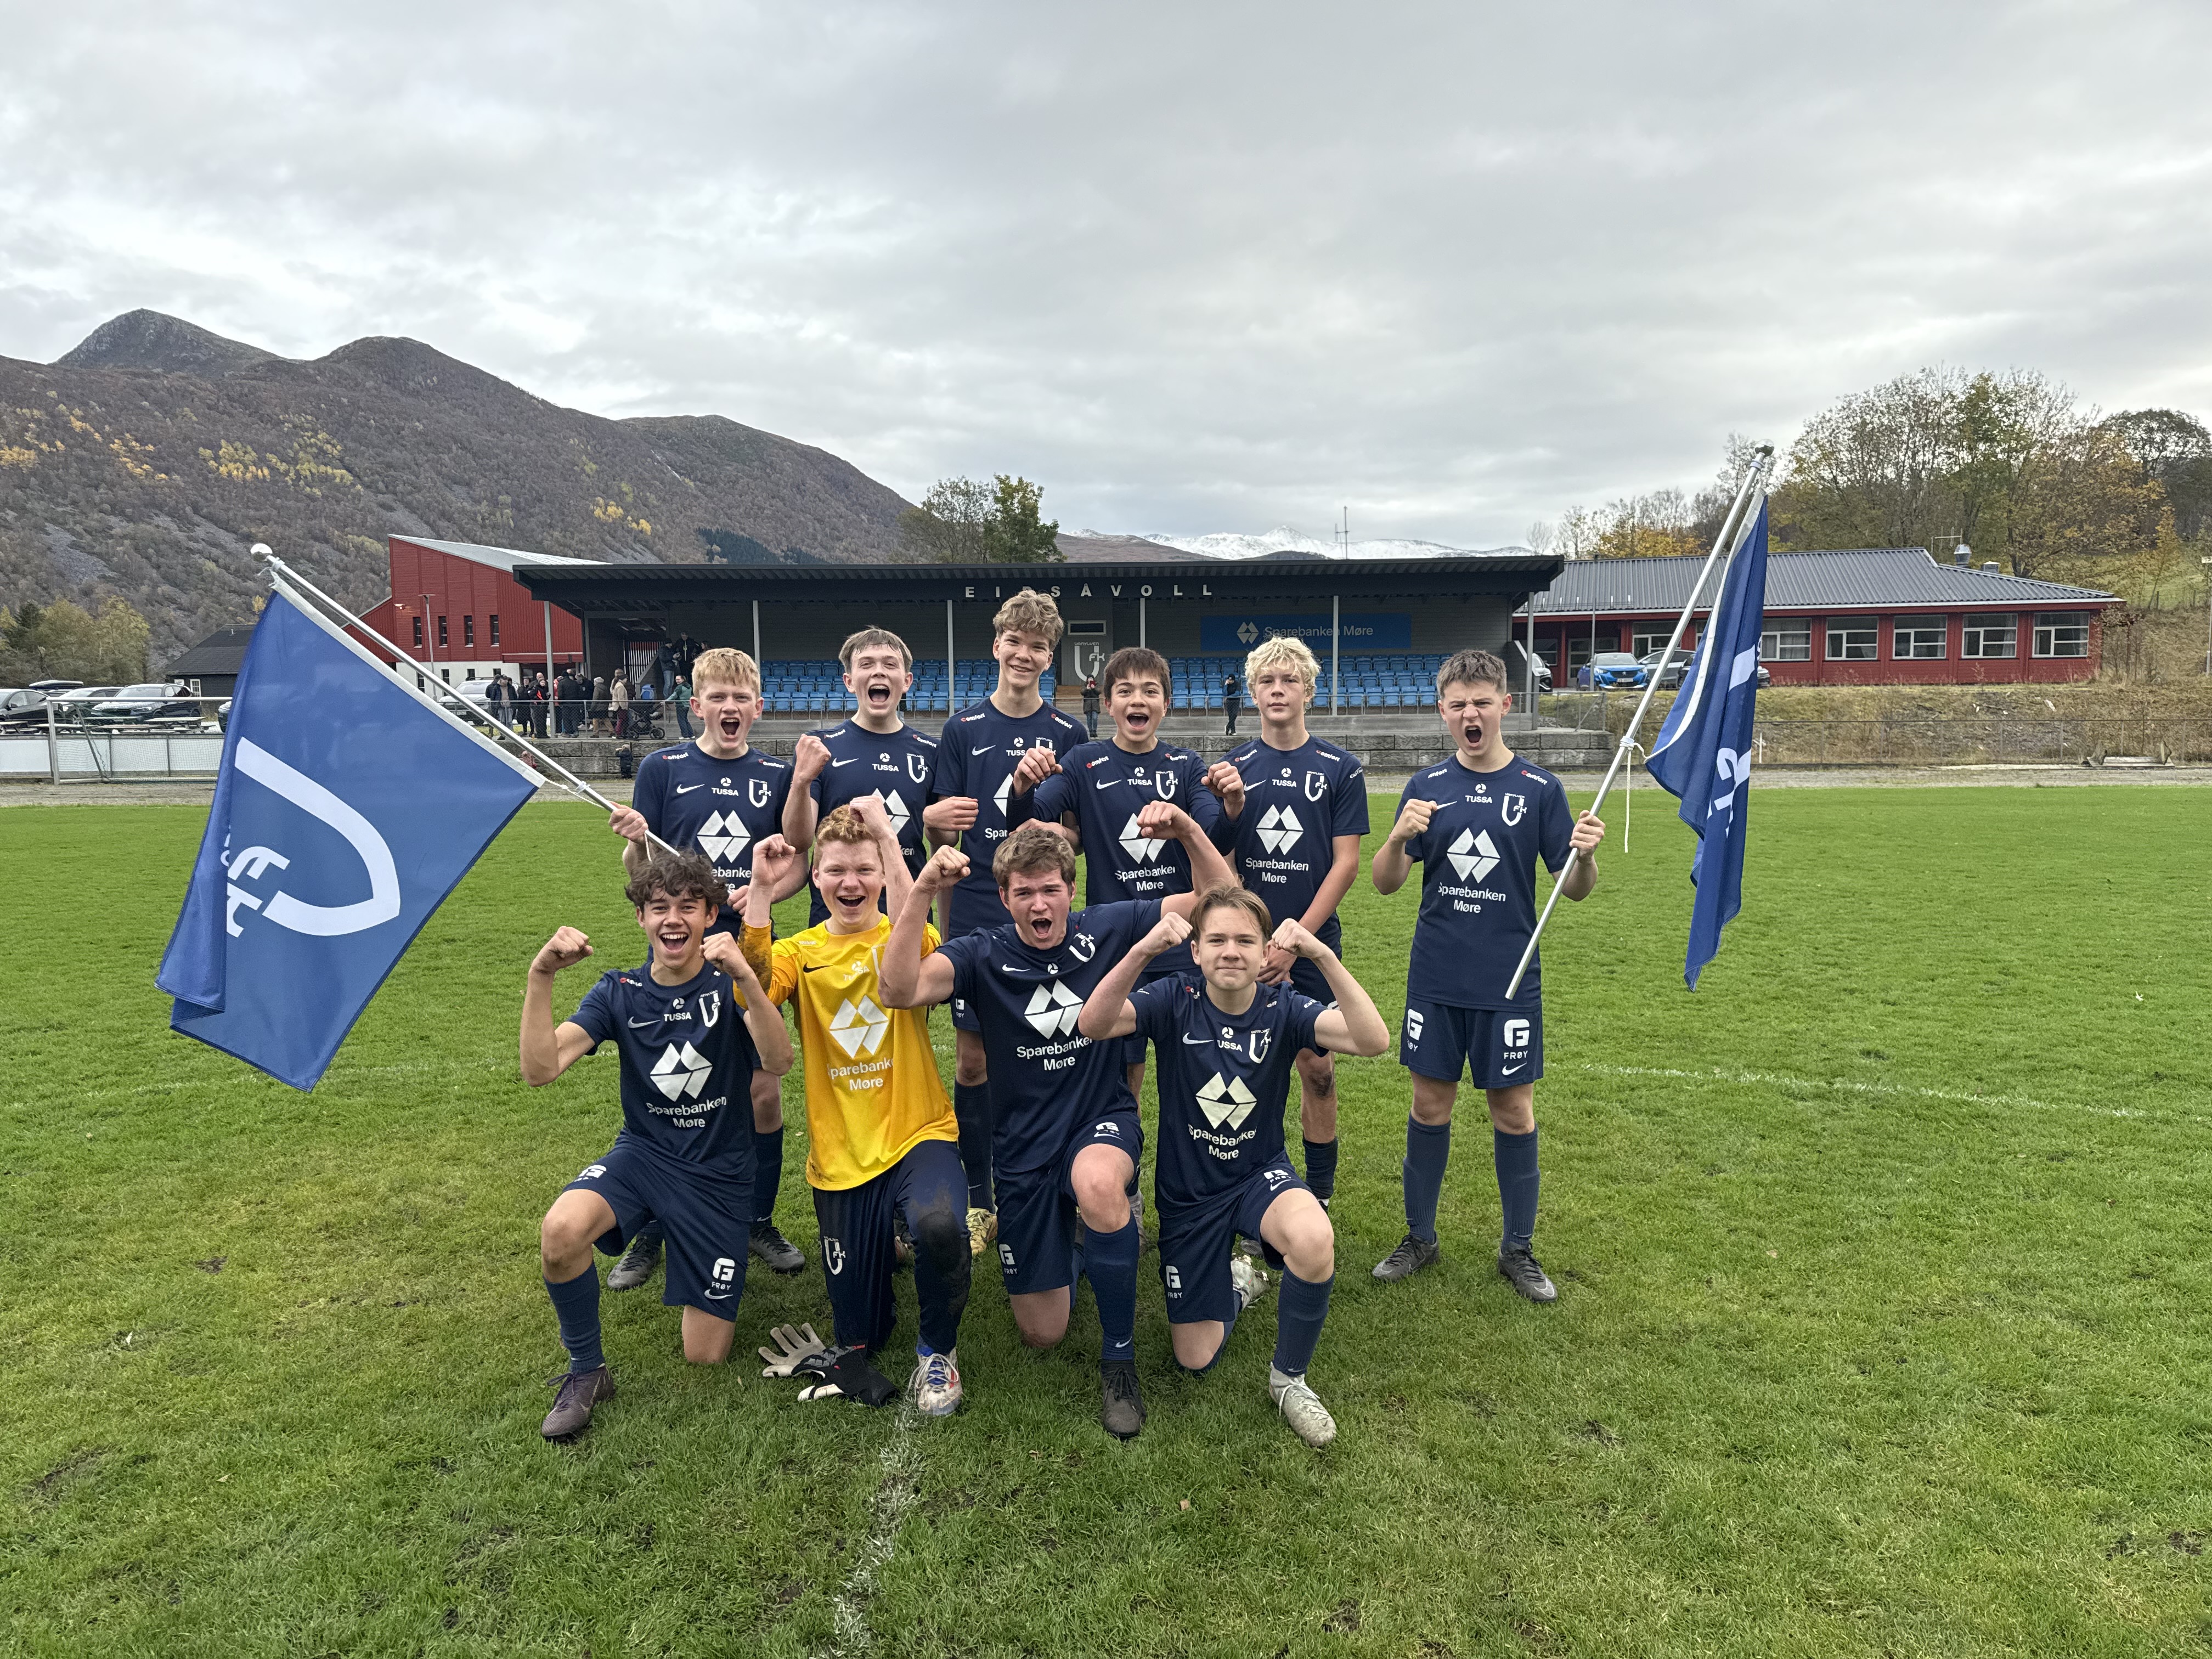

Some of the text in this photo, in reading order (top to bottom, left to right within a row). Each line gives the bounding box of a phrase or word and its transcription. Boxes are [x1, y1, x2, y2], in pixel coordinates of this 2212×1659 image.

[1343, 625, 1374, 636] Møre
[961, 713, 985, 722] Comfort
[1051, 713, 1073, 729] Comfort
[912, 734, 937, 748] Comfort
[662, 752, 689, 760] Comfort
[1316, 750, 1340, 762] Comfort
[758, 759, 785, 769] Comfort
[872, 763, 899, 772] TUSSA
[1086, 756, 1109, 769] Comfort
[1521, 770, 1548, 785] Comfort
[1272, 779, 1297, 788] TUSSA
[711, 787, 739, 797] TUSSA
[1465, 795, 1493, 804] TUSSA
[1245, 857, 1309, 871] Sparebanken
[1262, 871, 1287, 883] Møre
[1136, 881, 1164, 891] Møre
[1453, 896, 1481, 913] Møre
[664, 1012, 692, 1022] TUSSA
[1504, 1050, 1528, 1060] FRØY
[1043, 1056, 1075, 1071] Møre
[849, 1077, 884, 1091] Møre
[646, 1096, 727, 1115] Sparebanken
[673, 1118, 706, 1128] Møre
[1209, 1144, 1239, 1160] Møre
[711, 1280, 731, 1291] FRØY
